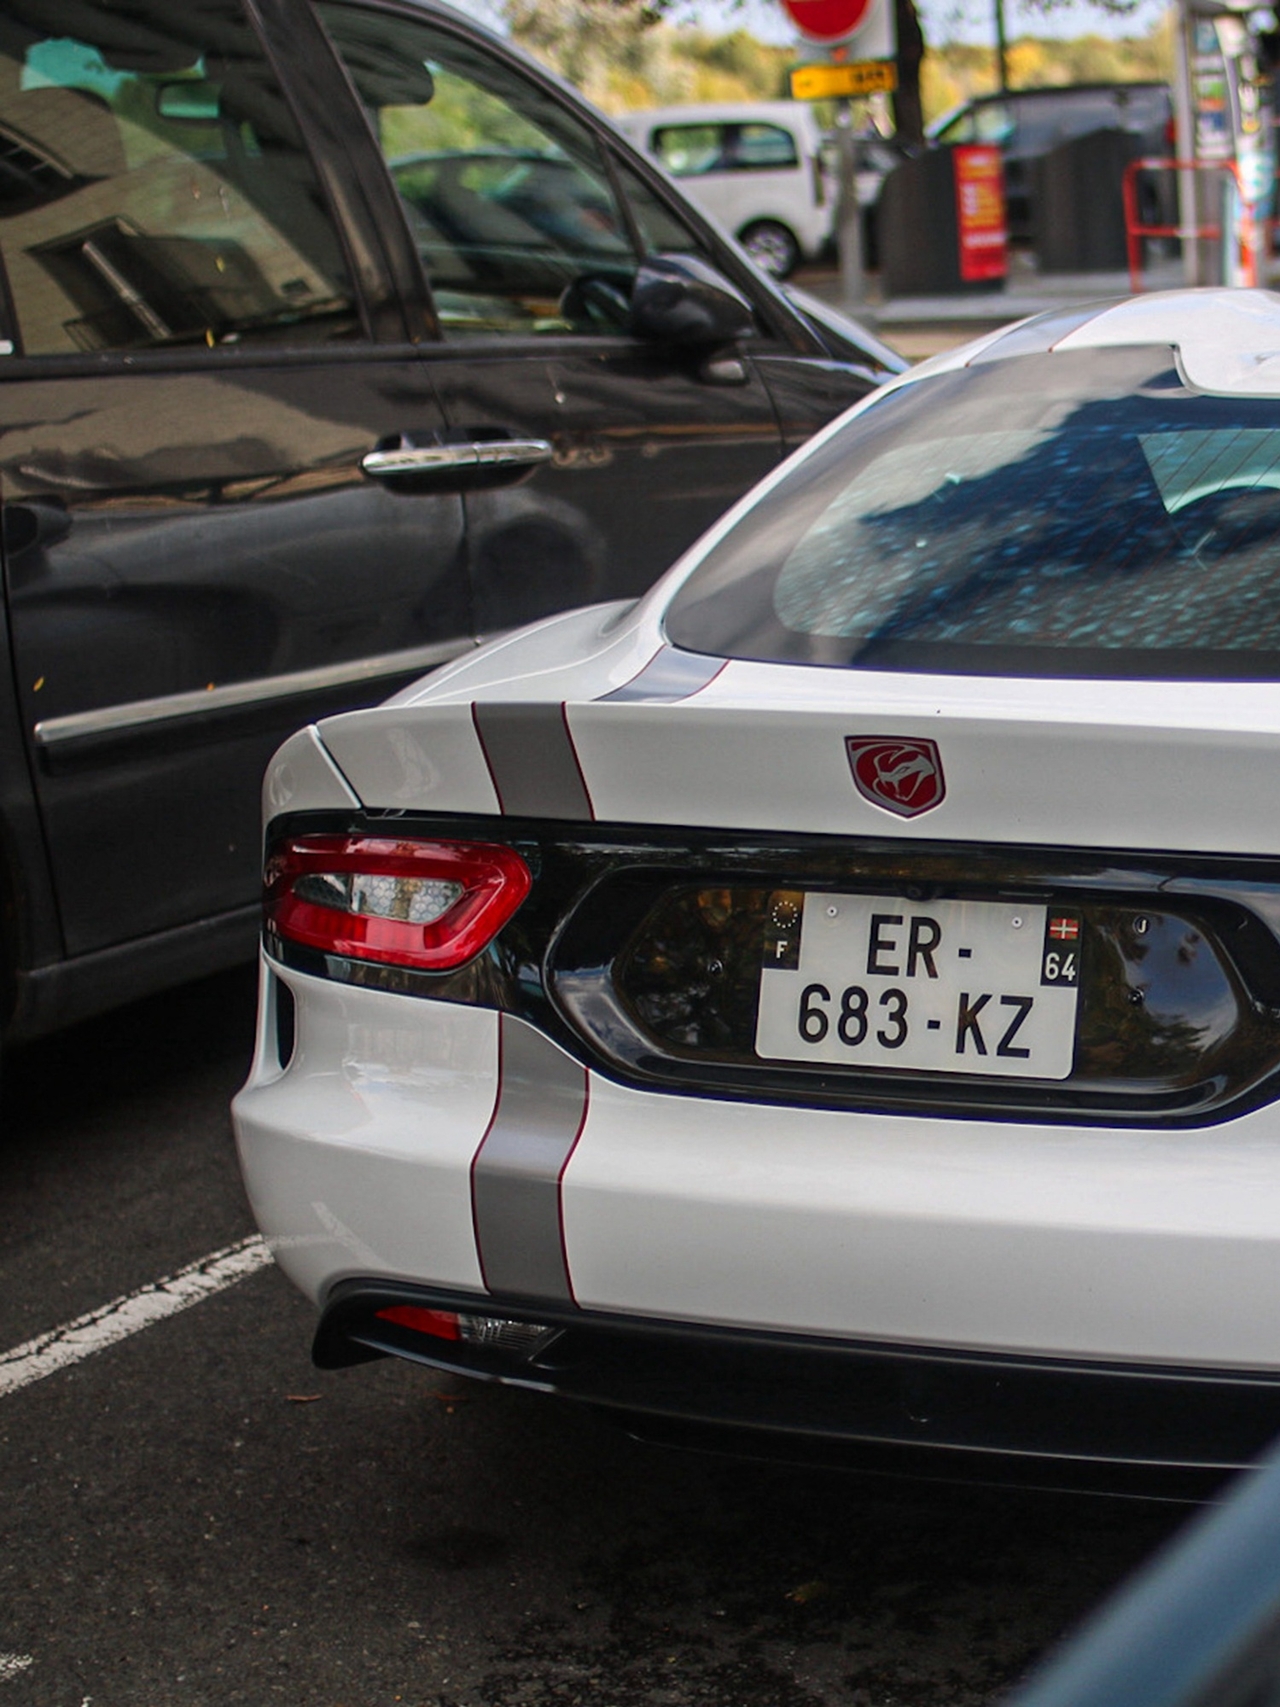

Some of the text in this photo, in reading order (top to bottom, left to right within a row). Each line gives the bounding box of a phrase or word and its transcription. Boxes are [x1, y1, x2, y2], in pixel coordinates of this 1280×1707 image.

[776, 940, 788, 959] F
[1045, 952, 1076, 982] 64
[798, 983, 1034, 1059] 683-KZ
